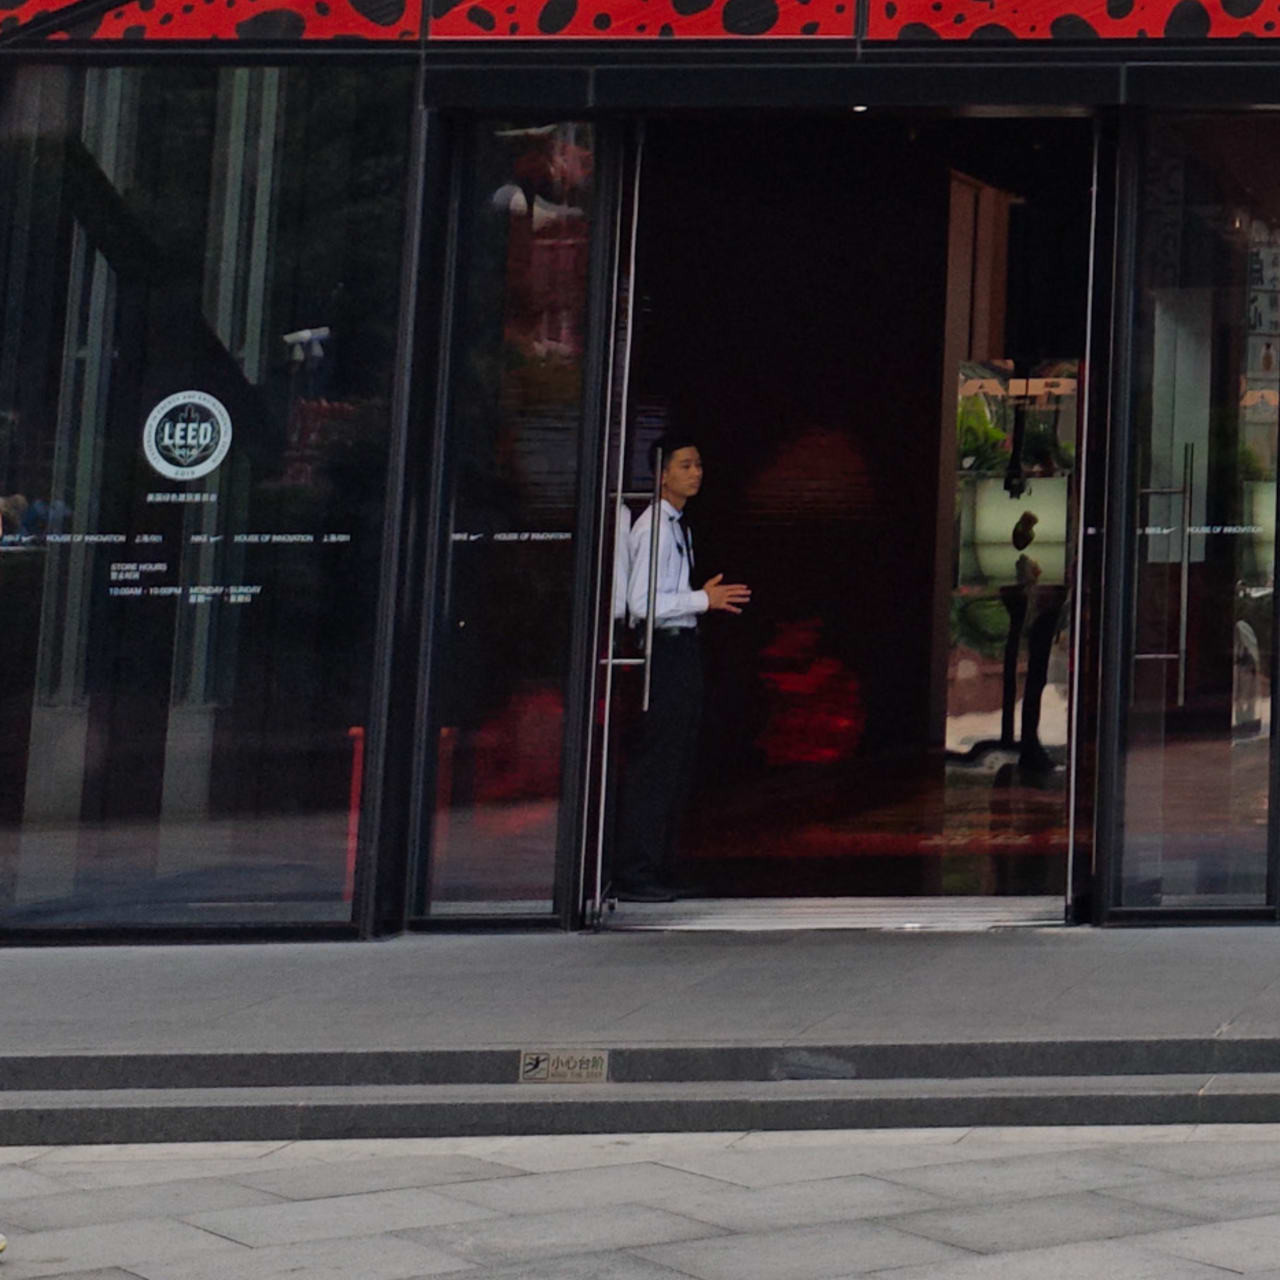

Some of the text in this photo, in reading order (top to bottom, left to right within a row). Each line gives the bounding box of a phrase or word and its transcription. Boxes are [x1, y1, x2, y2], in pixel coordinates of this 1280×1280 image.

[163, 422, 212, 446] LEED
[551, 1056, 604, 1071] 小心台阶
